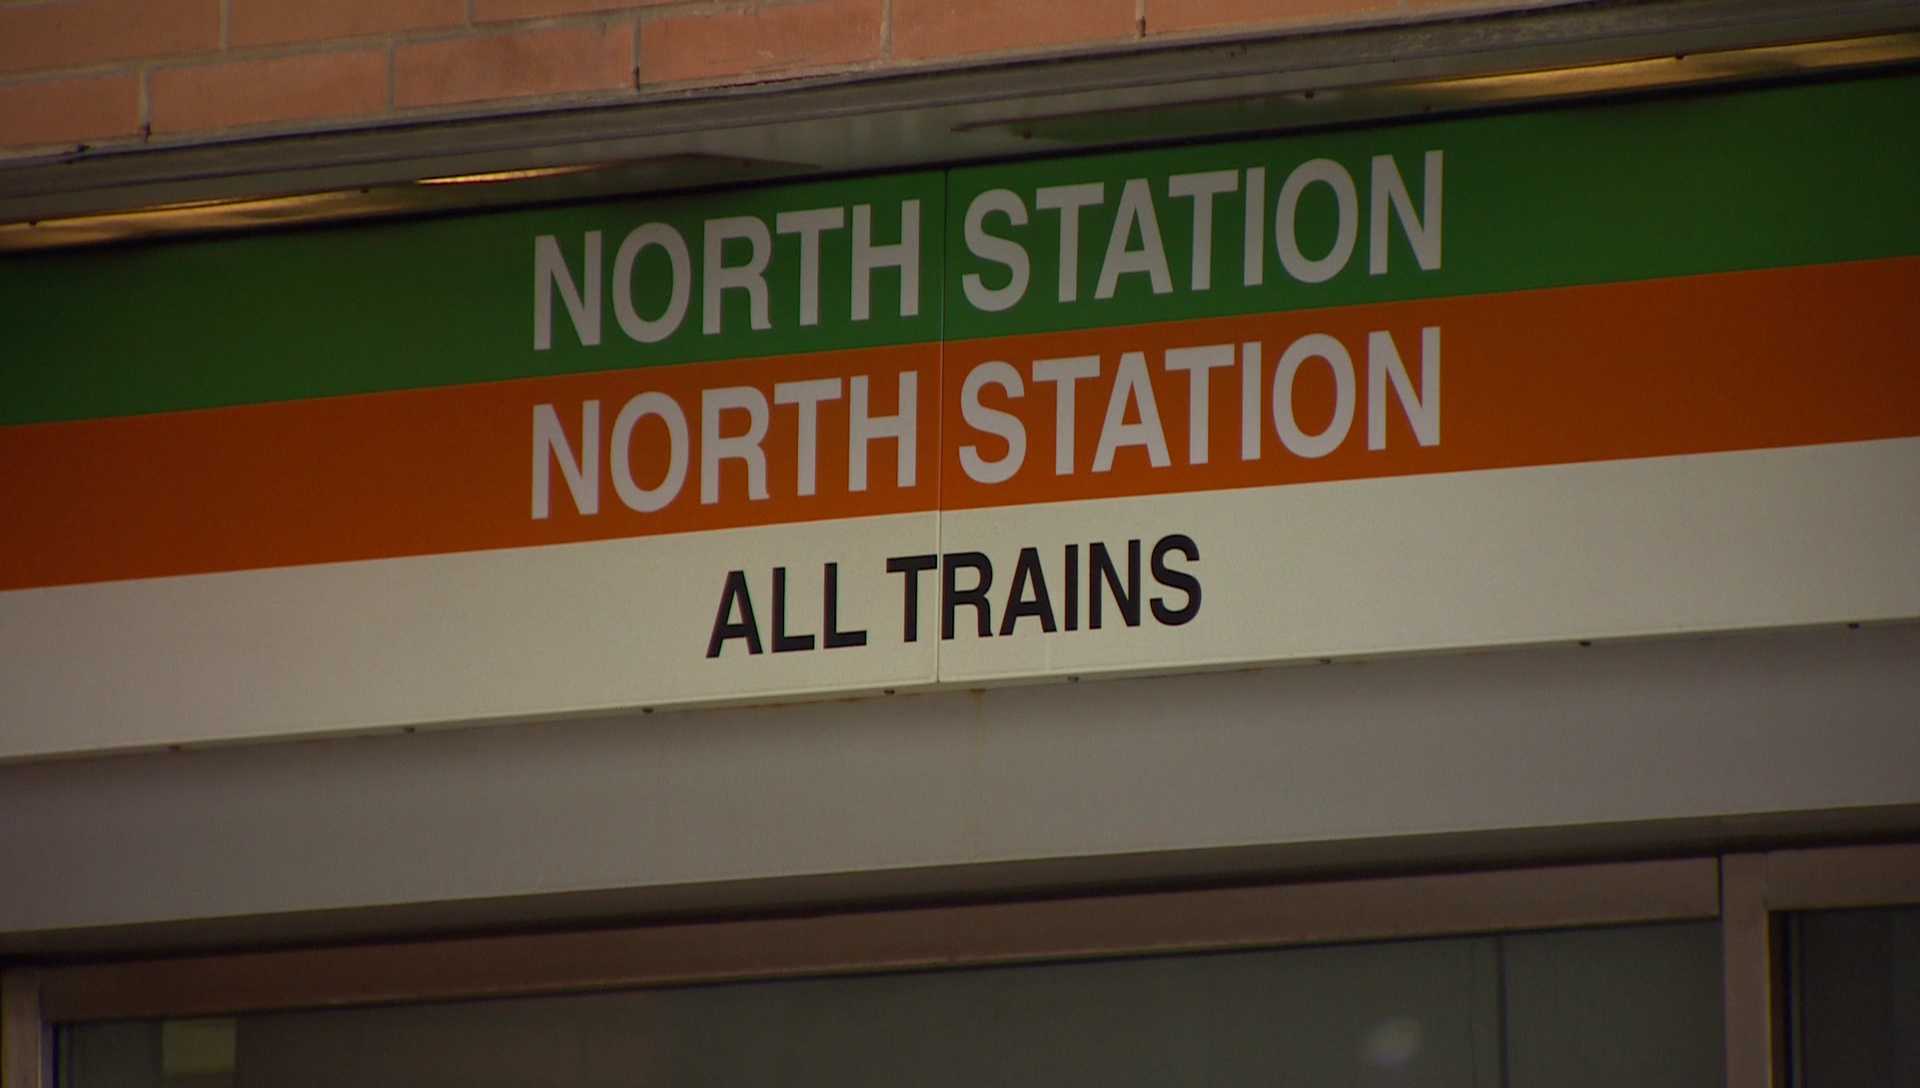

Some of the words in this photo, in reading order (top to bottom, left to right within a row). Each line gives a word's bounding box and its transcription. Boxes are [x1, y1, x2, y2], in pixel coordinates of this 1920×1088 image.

[533, 200, 921, 351] NORTH
[961, 149, 1443, 312] STATION
[531, 371, 918, 520] NORTH
[958, 326, 1441, 485] STATION
[706, 562, 868, 659] ALL
[886, 534, 1202, 643] TRAINS
